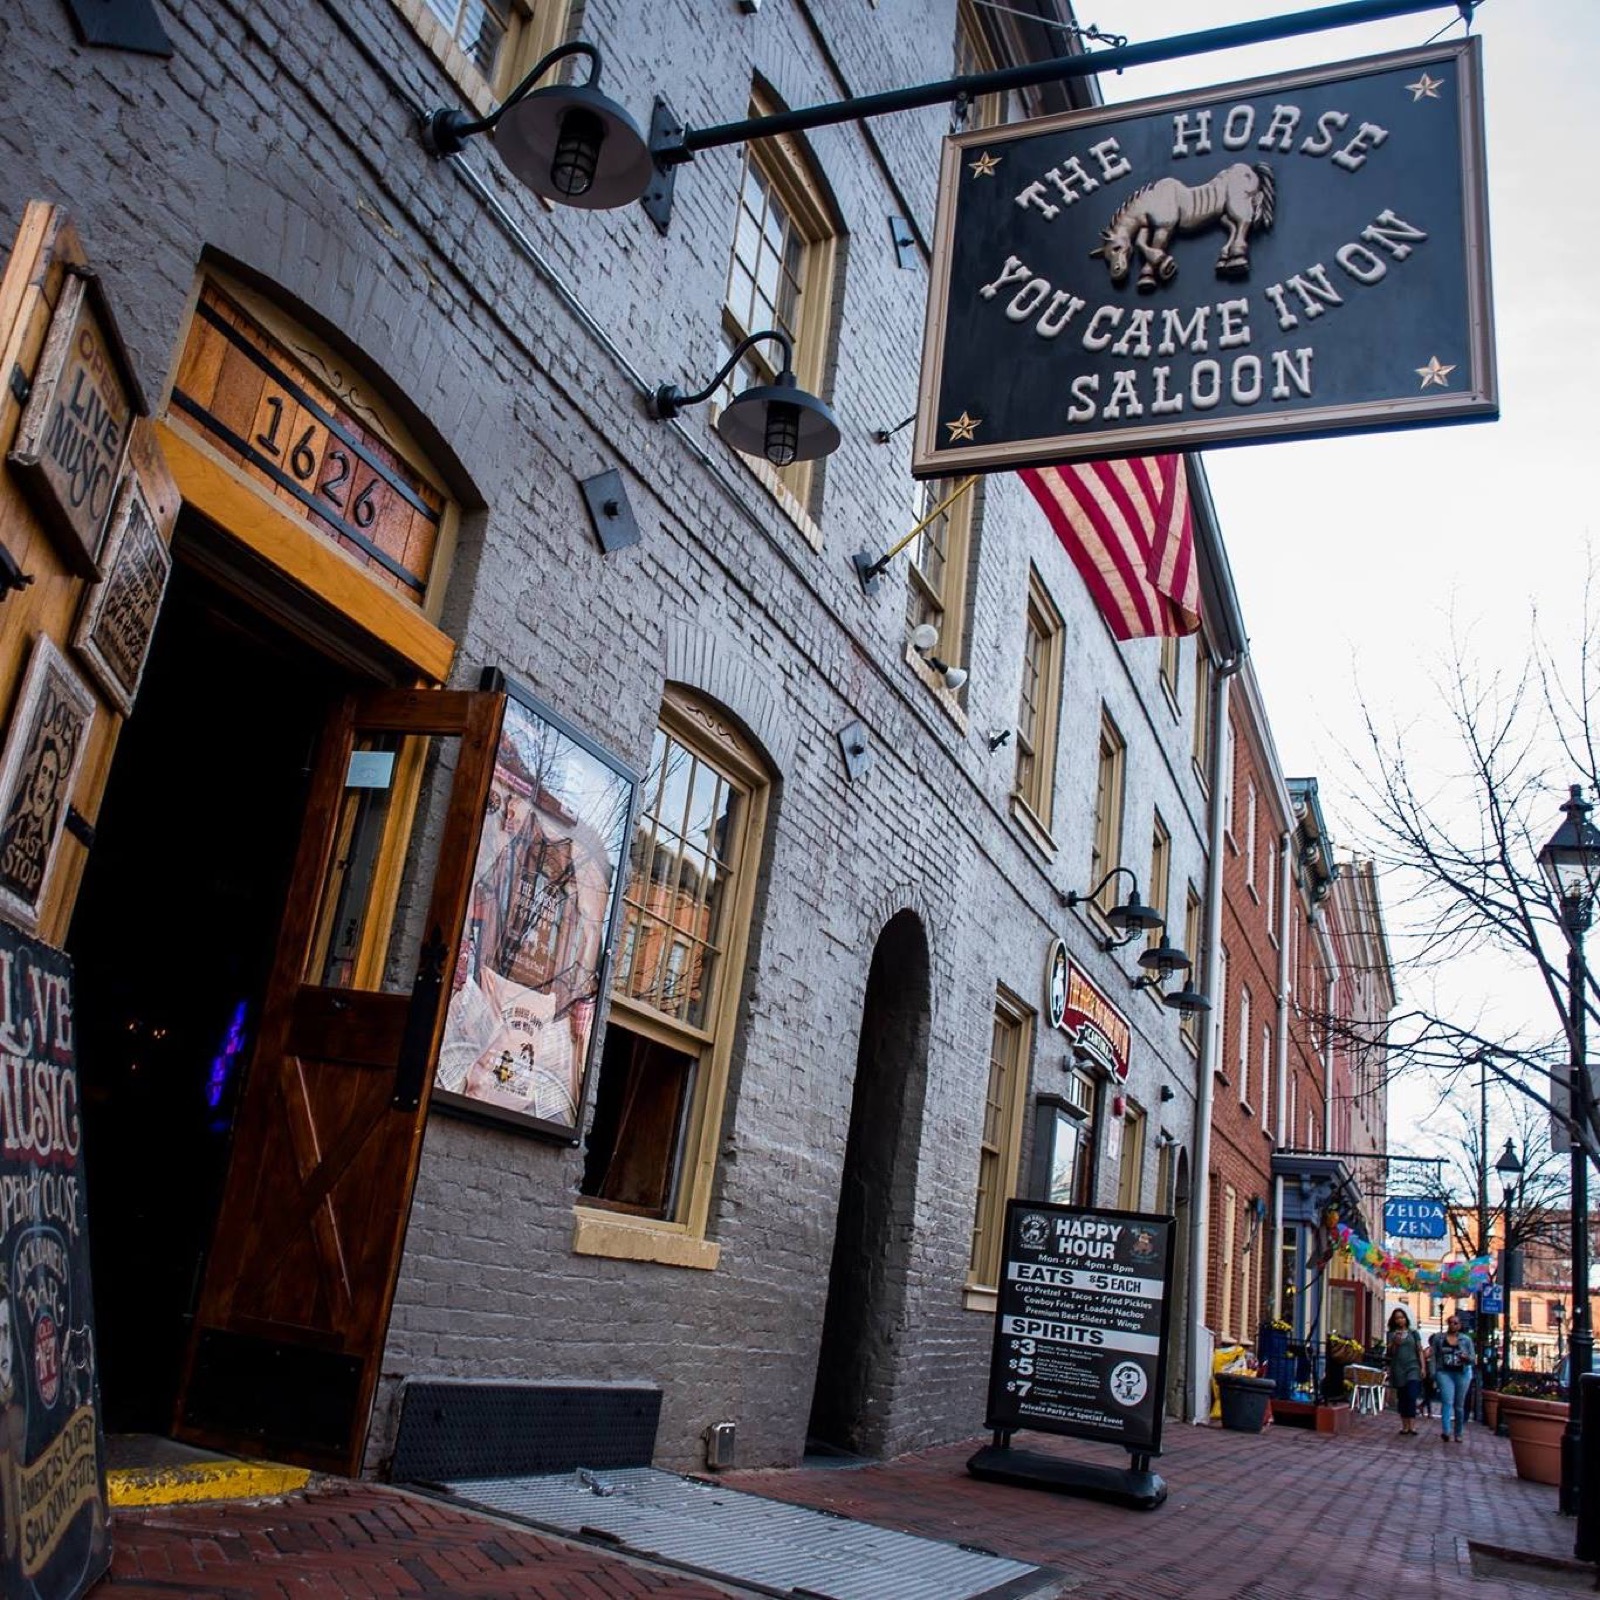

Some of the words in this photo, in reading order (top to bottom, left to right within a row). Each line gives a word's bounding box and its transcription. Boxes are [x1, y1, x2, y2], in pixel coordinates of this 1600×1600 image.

[1015, 136, 1132, 220] THE
[1171, 104, 1388, 172] HORSE
[980, 255, 1085, 340] YOU
[1083, 298, 1250, 358] CAME
[1266, 263, 1344, 330] IN
[1337, 208, 1428, 285] ON
[1067, 347, 1313, 423] SALOON
[70, 367, 119, 460] LIVE
[256, 396, 379, 528] 1626
[1, 844, 40, 889] STOP
[0, 1174, 29, 1240] PEN
[1386, 1203, 1444, 1218] ZELDA
[1056, 1219, 1122, 1242] HAPPY
[1397, 1220, 1432, 1235] ZEN
[1058, 1238, 1115, 1259] HOUR
[1038, 1254, 1058, 1264] Mon
[1065, 1257, 1079, 1265] Fri
[1084, 1260, 1105, 1271] 4pm
[1017, 1264, 1074, 1285] EATS
[1089, 1274, 1108, 1290] $5
[1111, 1277, 1141, 1293] EACH
[1015, 1283, 1033, 1293] Crab
[1034, 1287, 1060, 1297] Pretzel
[1071, 1291, 1092, 1301] Tacos
[1102, 1296, 1123, 1305] Fried
[1124, 1298, 1152, 1309] Pickles
[1023, 1296, 1054, 1308] Cowboy
[1056, 1300, 1075, 1309] Fries
[1084, 1304, 1113, 1315] Loaded
[1115, 1308, 1144, 1319] Nachos
[1025, 1305, 1060, 1317] Premium
[1061, 1310, 1079, 1320] Beef
[1081, 1313, 1107, 1324] Sliders
[1116, 1319, 1141, 1330] Wings
[1011, 1318, 1104, 1345] SPIRITS
[1010, 1338, 1036, 1355] $3
[1009, 1357, 1034, 1375] $5
[1006, 1380, 1032, 1397] $7
[1020, 1402, 1046, 1412] Private
[1046, 1407, 1065, 1416] Party
[1077, 1412, 1102, 1421] Special
[1104, 1416, 1123, 1425] Event
